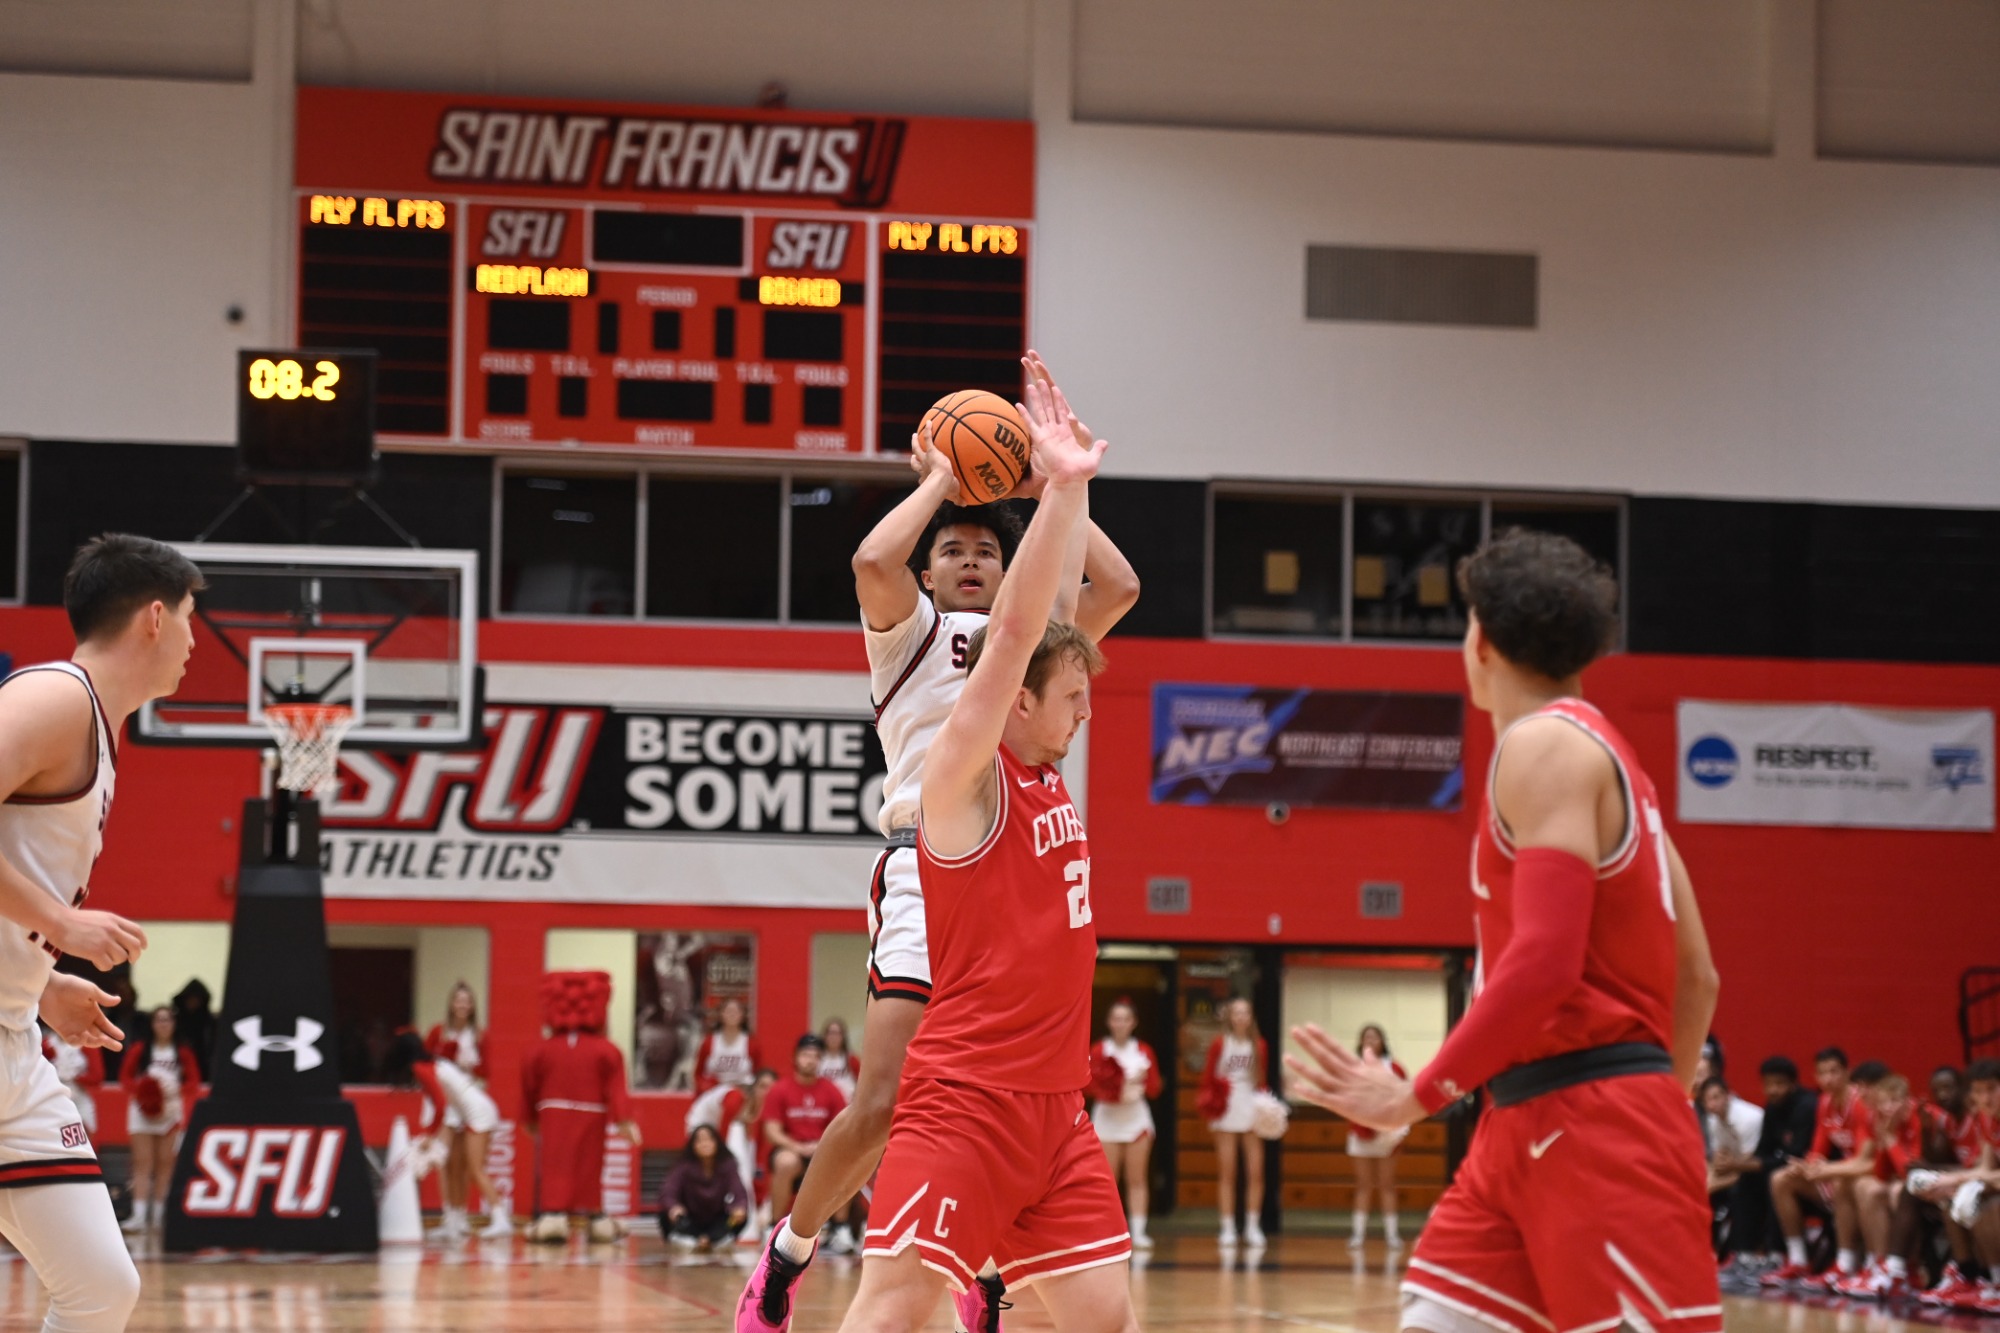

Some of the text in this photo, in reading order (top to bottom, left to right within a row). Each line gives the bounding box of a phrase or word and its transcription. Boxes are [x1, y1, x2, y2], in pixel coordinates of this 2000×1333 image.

[432, 110, 609, 185] SAINT
[604, 119, 859, 194] FRANCIS
[481, 209, 566, 258] SFU
[766, 222, 850, 271] SFU
[249, 359, 340, 402] 08.2
[626, 716, 864, 768] BECOME
[1161, 721, 1270, 769] NEC
[60, 1122, 87, 1148] SFU
[184, 1127, 345, 1215] SFU
[934, 1197, 957, 1238] C
